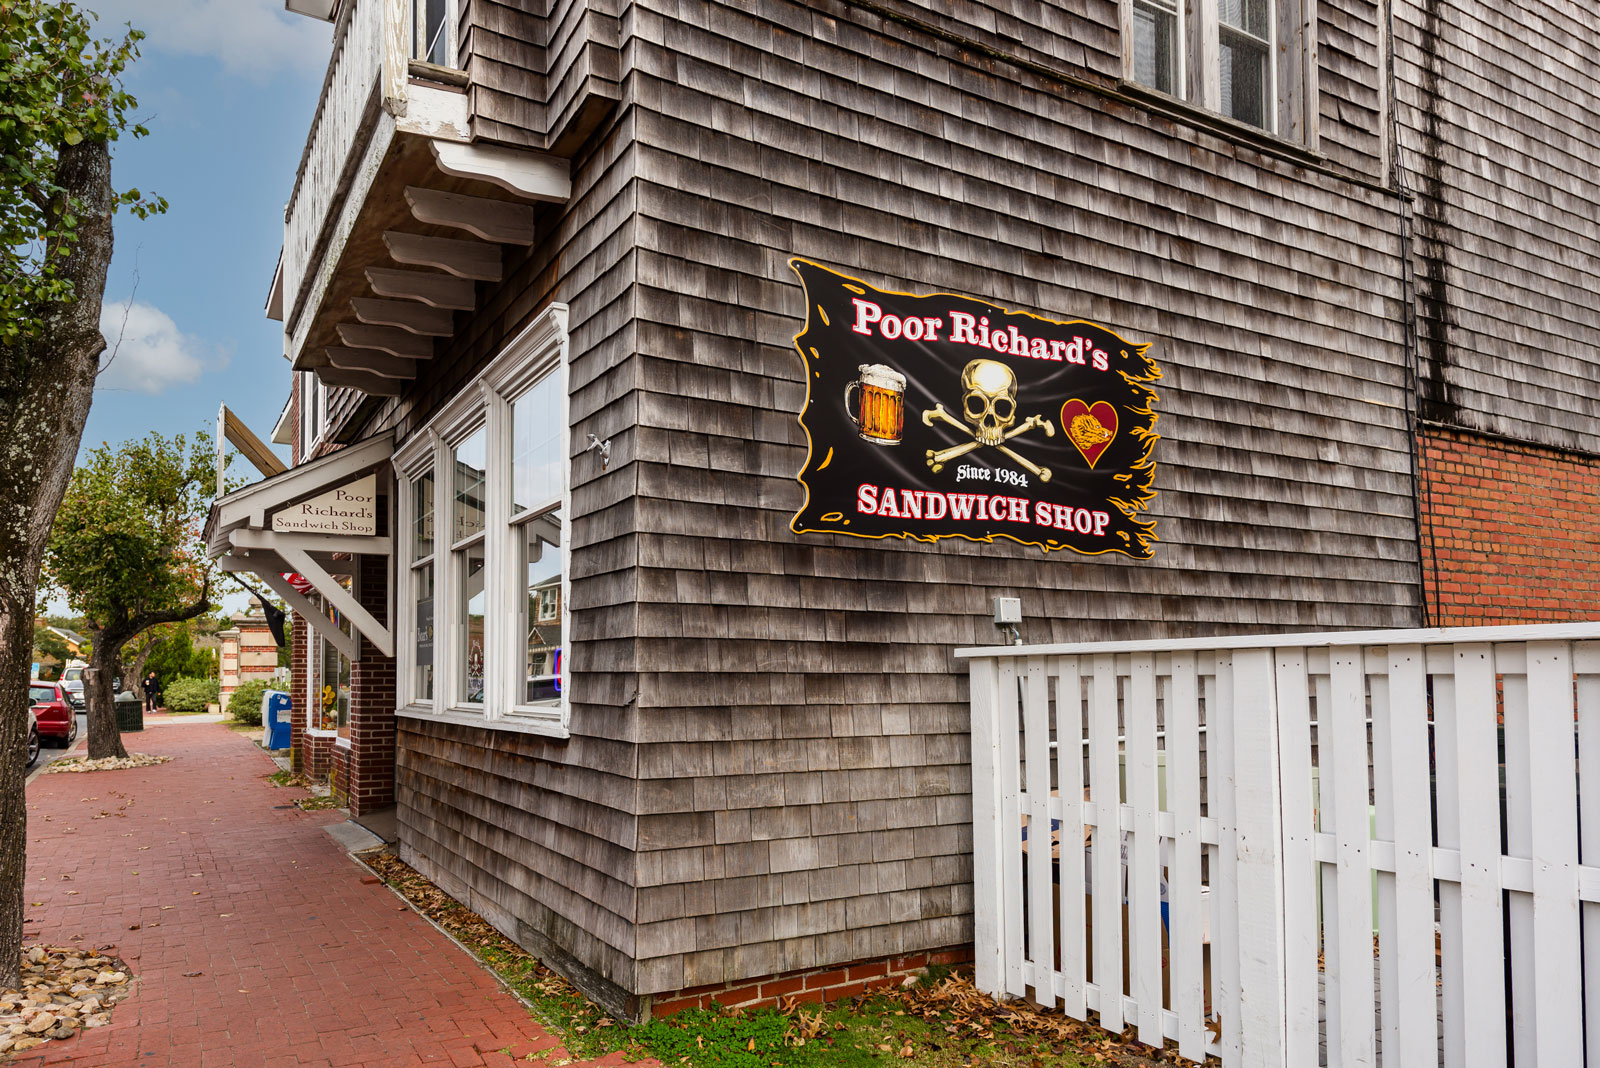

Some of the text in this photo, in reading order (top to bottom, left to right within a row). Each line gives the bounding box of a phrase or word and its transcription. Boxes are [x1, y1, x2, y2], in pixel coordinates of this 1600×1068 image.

[852, 298, 1109, 371] Poor Richard's
[956, 464, 1029, 488] Since 1984
[336, 490, 373, 503] Poor
[301, 504, 373, 519] Richard's
[857, 484, 1110, 536] SANDWICH SHOP
[276, 518, 373, 533] Sandwich Shop
